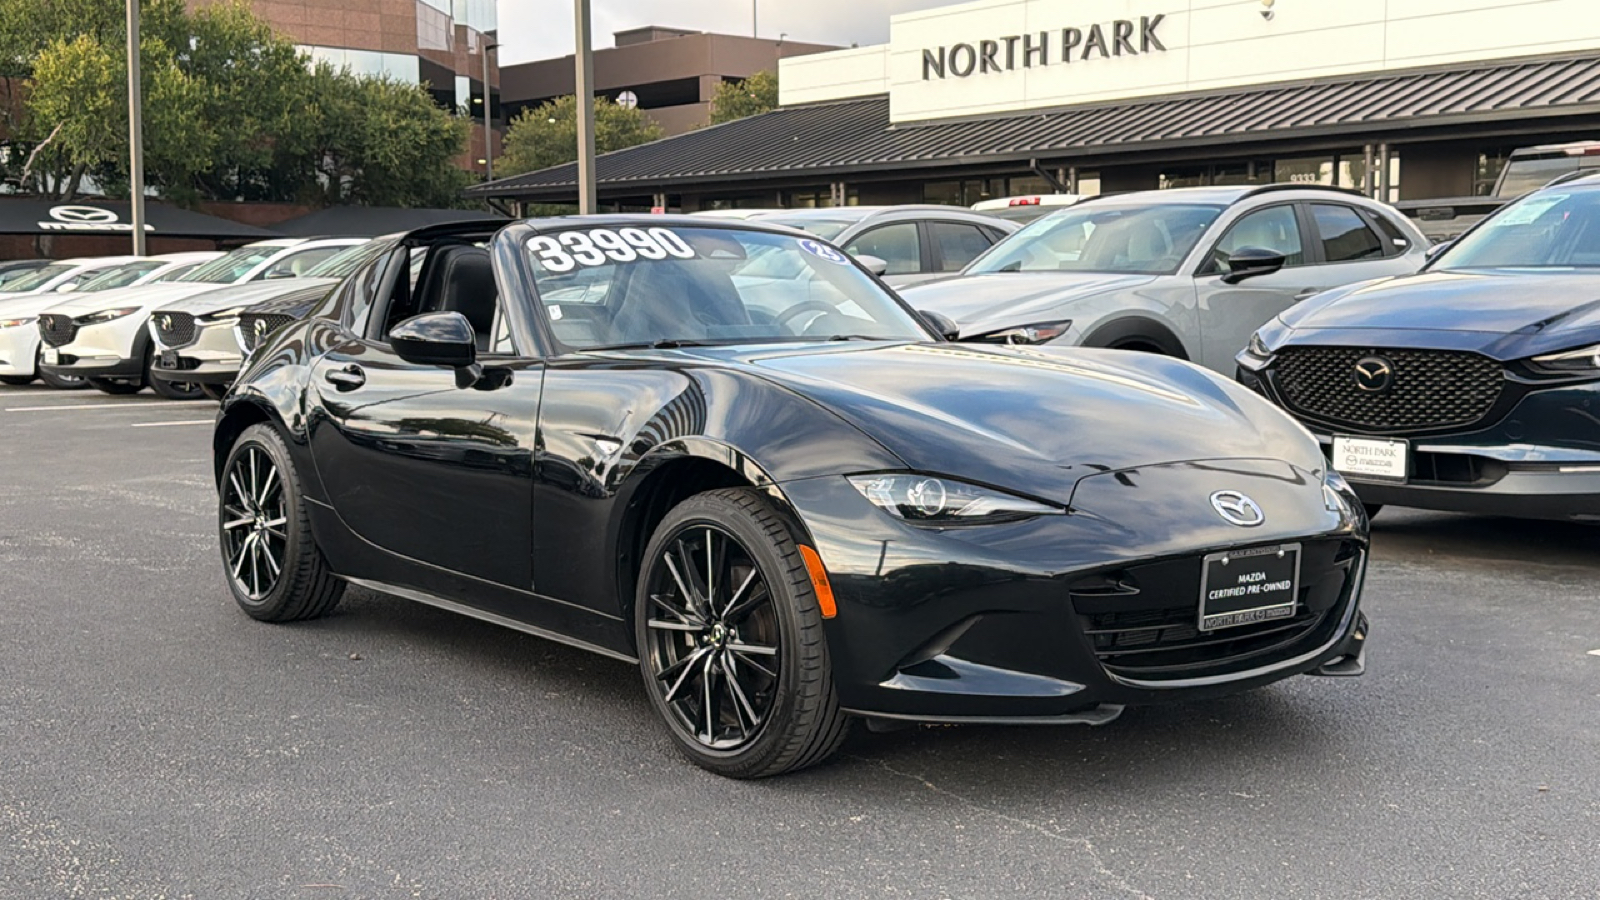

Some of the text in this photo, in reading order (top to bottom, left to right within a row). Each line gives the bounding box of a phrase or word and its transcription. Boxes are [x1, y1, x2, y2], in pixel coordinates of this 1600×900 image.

[922, 14, 1167, 81] NORTH PARK
[526, 227, 696, 272] 33990
[1343, 445, 1397, 457] NORTH PARK
[1359, 458, 1393, 467] mazda
[1238, 571, 1266, 584] MAZDA
[1208, 580, 1291, 600] CERTIFIED PRE-OWNED
[1204, 615, 1233, 628] NORTH
[1234, 612, 1256, 623] PARK
